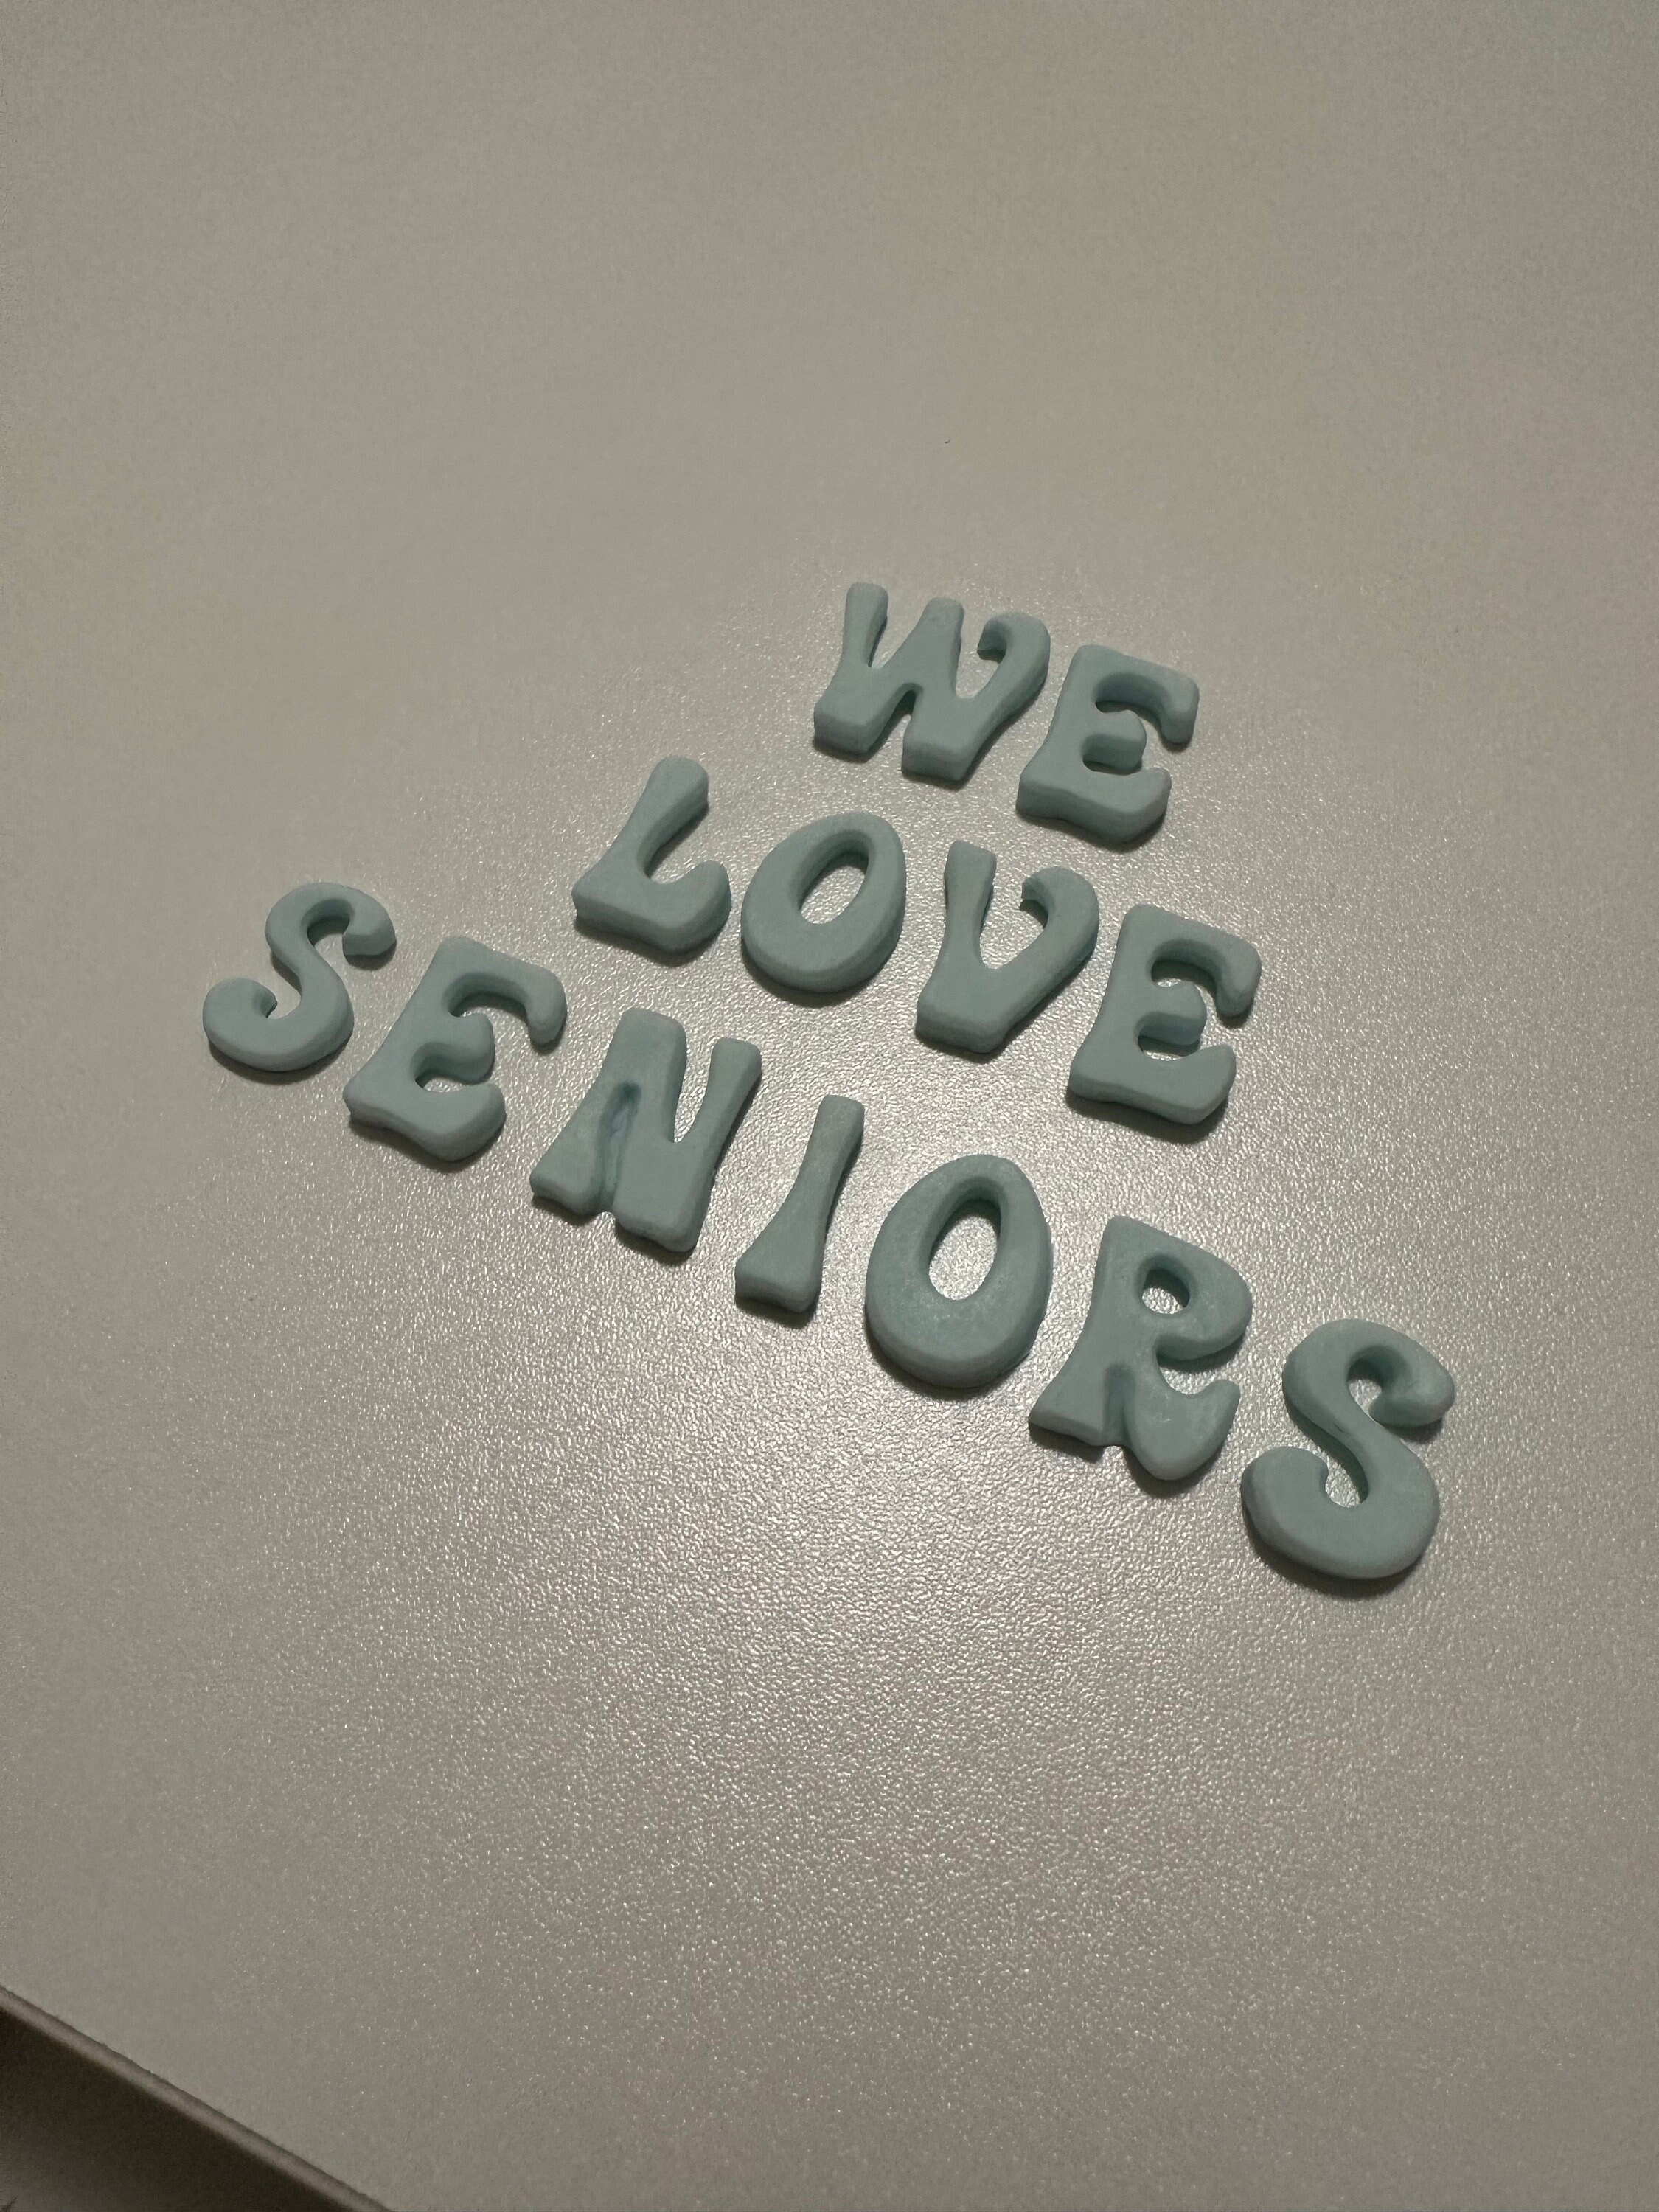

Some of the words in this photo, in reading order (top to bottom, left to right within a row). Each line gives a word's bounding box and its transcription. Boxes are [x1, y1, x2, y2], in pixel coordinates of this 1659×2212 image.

[814, 583, 1198, 844] WE
[574, 757, 1261, 1124] LOVE
[204, 884, 1453, 1579] SENIORS
